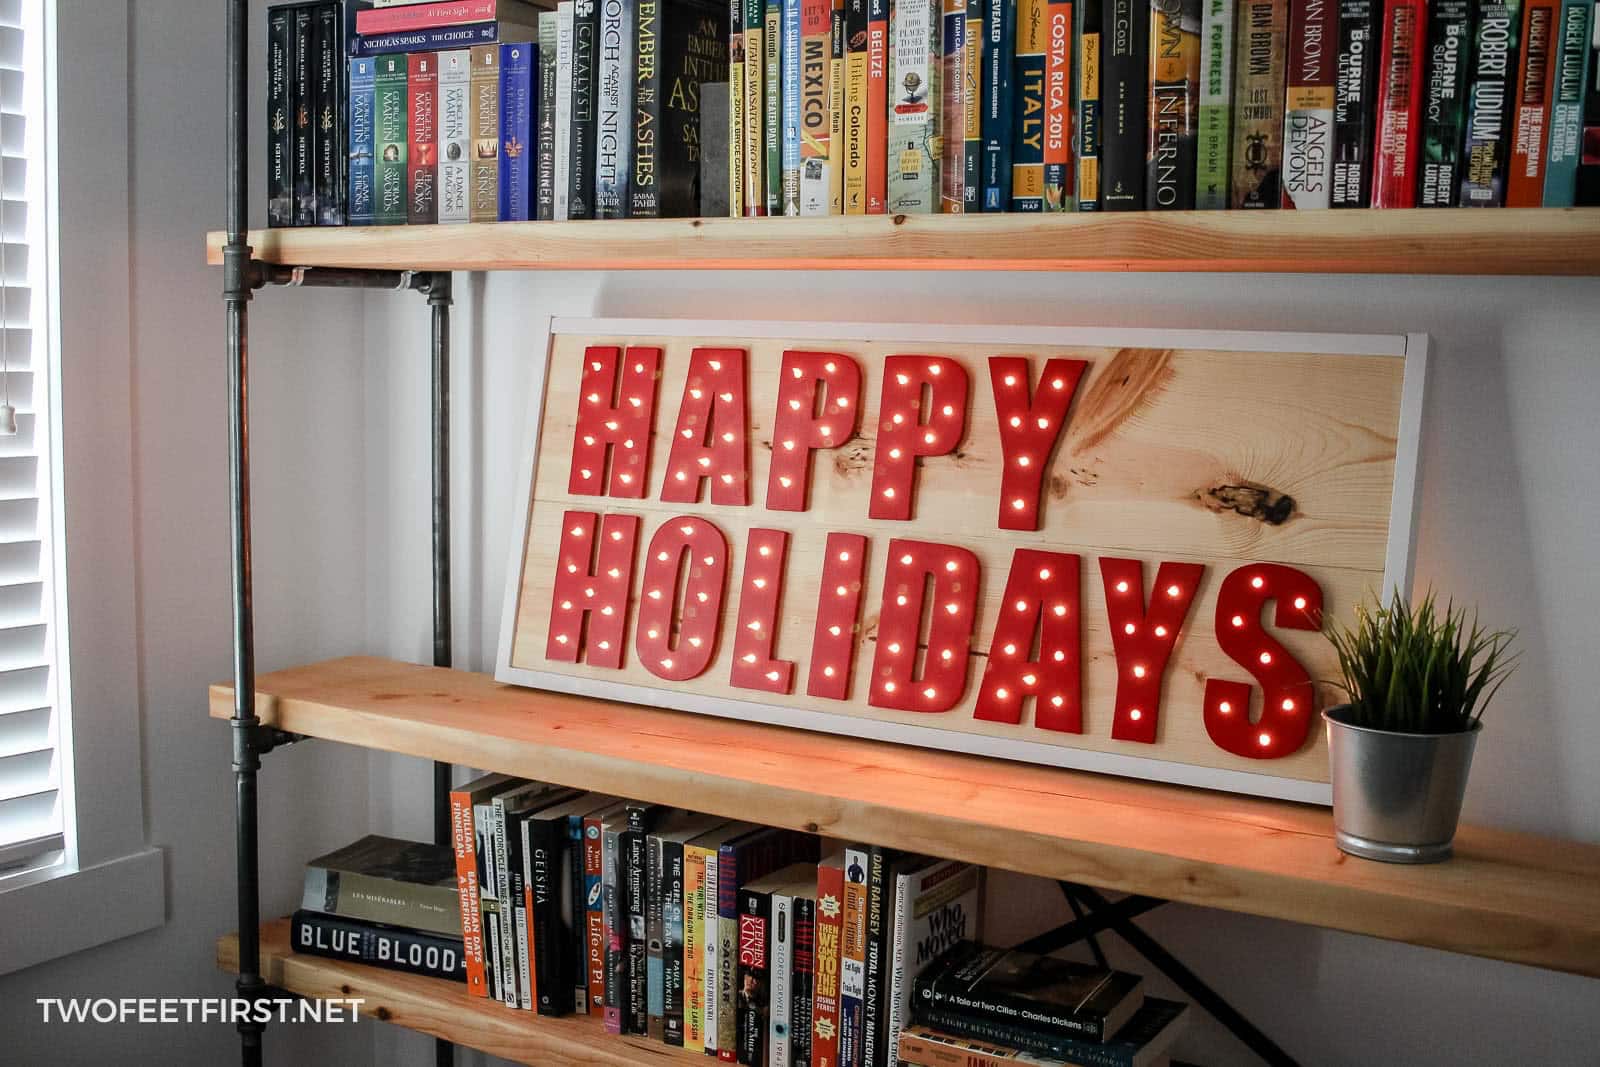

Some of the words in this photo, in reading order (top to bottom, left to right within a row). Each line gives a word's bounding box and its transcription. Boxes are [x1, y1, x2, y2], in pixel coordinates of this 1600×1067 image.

[1117, 20, 1128, 54] CODE
[1252, 4, 1272, 28] DAN
[1528, 10, 1546, 54] ROBERT
[1566, 7, 1585, 52] ROBERT
[363, 36, 400, 49] NICHOLAS
[400, 35, 426, 45] SPARKS
[444, 30, 474, 40] CHOICE
[639, 2, 656, 84] EMBER
[768, 20, 776, 58] Colorado
[872, 31, 882, 78] BELIZE
[1052, 14, 1066, 67] COSTA
[1210, 25, 1222, 96] FORTRESS
[1249, 32, 1272, 76] BROWN
[1302, 24, 1322, 81] BROWN
[1478, 19, 1510, 76] ROBERT
[578, 26, 591, 120] CATALYST
[849, 58, 862, 103] Hiking
[1348, 30, 1364, 102] BOURNE
[1428, 45, 1444, 122] SUPREMACY
[1442, 25, 1460, 98] BOURNE
[1560, 54, 1582, 100] LUDLUM
[603, 74, 611, 98] THE
[610, 64, 620, 108] AGAINST
[645, 88, 654, 104] IN
[805, 41, 823, 128] MEXICO
[1050, 72, 1064, 110] RICA
[1250, 89, 1268, 104] LOST
[1336, 54, 1350, 122] ULTIMATUM
[355, 94, 364, 143] MARTIN
[384, 92, 393, 141] MARTIN
[416, 93, 425, 142] MARTIN
[446, 89, 456, 139] MARTIN
[480, 85, 490, 136] MARTIN
[749, 80, 758, 134] WASATCH
[768, 96, 776, 126] BEATEN
[1024, 70, 1042, 150] ITALY
[1084, 104, 1093, 152] ITALIAN
[1210, 109, 1219, 130] DAN
[1243, 106, 1272, 120] SYMBOL
[1397, 112, 1408, 132] THE
[1472, 81, 1504, 140] LUDLUM
[1532, 107, 1544, 125] THE
[1568, 105, 1580, 122] THE
[541, 121, 552, 150] KITE
[600, 110, 618, 184] NIGHT
[637, 108, 654, 186] ASHES
[850, 106, 861, 168] Colorado
[1050, 113, 1062, 149] 2015
[1155, 85, 1188, 205] INFERNO
[1517, 106, 1532, 154] EXCHANGE
[1526, 125, 1542, 176] RHINEMANN
[1552, 104, 1568, 162] CONTENDERS
[1564, 122, 1578, 156] GEMINI
[750, 137, 758, 176] FRONT
[1208, 136, 1218, 172] BROWN
[1288, 116, 1308, 192] DEMONS
[1306, 116, 1326, 192] ANGELS
[1393, 134, 1406, 176] BOURNE
[384, 168, 393, 212] SWORDS
[416, 170, 425, 213] CROWS
[445, 166, 454, 215] DRAGONS
[478, 166, 488, 208] KINGS
[540, 153, 552, 204] RUNNER
[1334, 162, 1347, 202] LUDLUM
[1346, 164, 1360, 202] ROBERT
[1424, 164, 1438, 204] LUDLUM
[1438, 164, 1452, 204] ROBERT
[568, 346, 1088, 531] HAPPY
[546, 510, 1324, 759] HOLIDAYS
[454, 801, 464, 859] FINNEGAN
[463, 808, 472, 854] WILLIAM
[495, 820, 506, 873] MOTORCYCLE
[632, 838, 642, 865] Lance
[499, 874, 508, 904] DIARIES
[536, 849, 545, 904] GEISHA
[630, 866, 642, 912] Armstrong
[872, 854, 882, 885] DAVE
[461, 887, 472, 932] SURFING
[468, 871, 480, 932] BARBARIAN
[664, 890, 672, 912] THE
[673, 908, 680, 922] ON
[848, 886, 857, 910] Food
[870, 886, 881, 936] RAMSEY
[301, 924, 360, 956] BLUE
[378, 938, 456, 972] BLOOD
[464, 936, 474, 956] LIFE
[473, 936, 482, 964] DAYS
[590, 917, 602, 946] Life
[664, 917, 672, 948] TRAIN
[742, 916, 755, 965] KING
[754, 917, 764, 968] STEPHEN
[819, 923, 838, 934] THEN
[819, 932, 838, 948] WE
[846, 921, 856, 958] Fitness
[592, 947, 602, 966] of
[592, 969, 602, 984] Pi
[722, 938, 732, 1002] SACHAR
[819, 956, 836, 976] TO
[869, 946, 878, 975] TOTAL
[895, 967, 903, 986] Who
[816, 996, 836, 1006] JOSHUA
[818, 972, 836, 986] THE
[818, 984, 836, 997] END
[867, 978, 877, 1020] MONEY
[816, 1003, 835, 1013] FERRIS
[893, 991, 902, 1020] Moved
[956, 996, 971, 1006] Tale
[981, 1001, 995, 1012] Two
[996, 1005, 1017, 1016] Cities
[1021, 1010, 1050, 1023] Charles
[1052, 1016, 1082, 1030] Dickens
